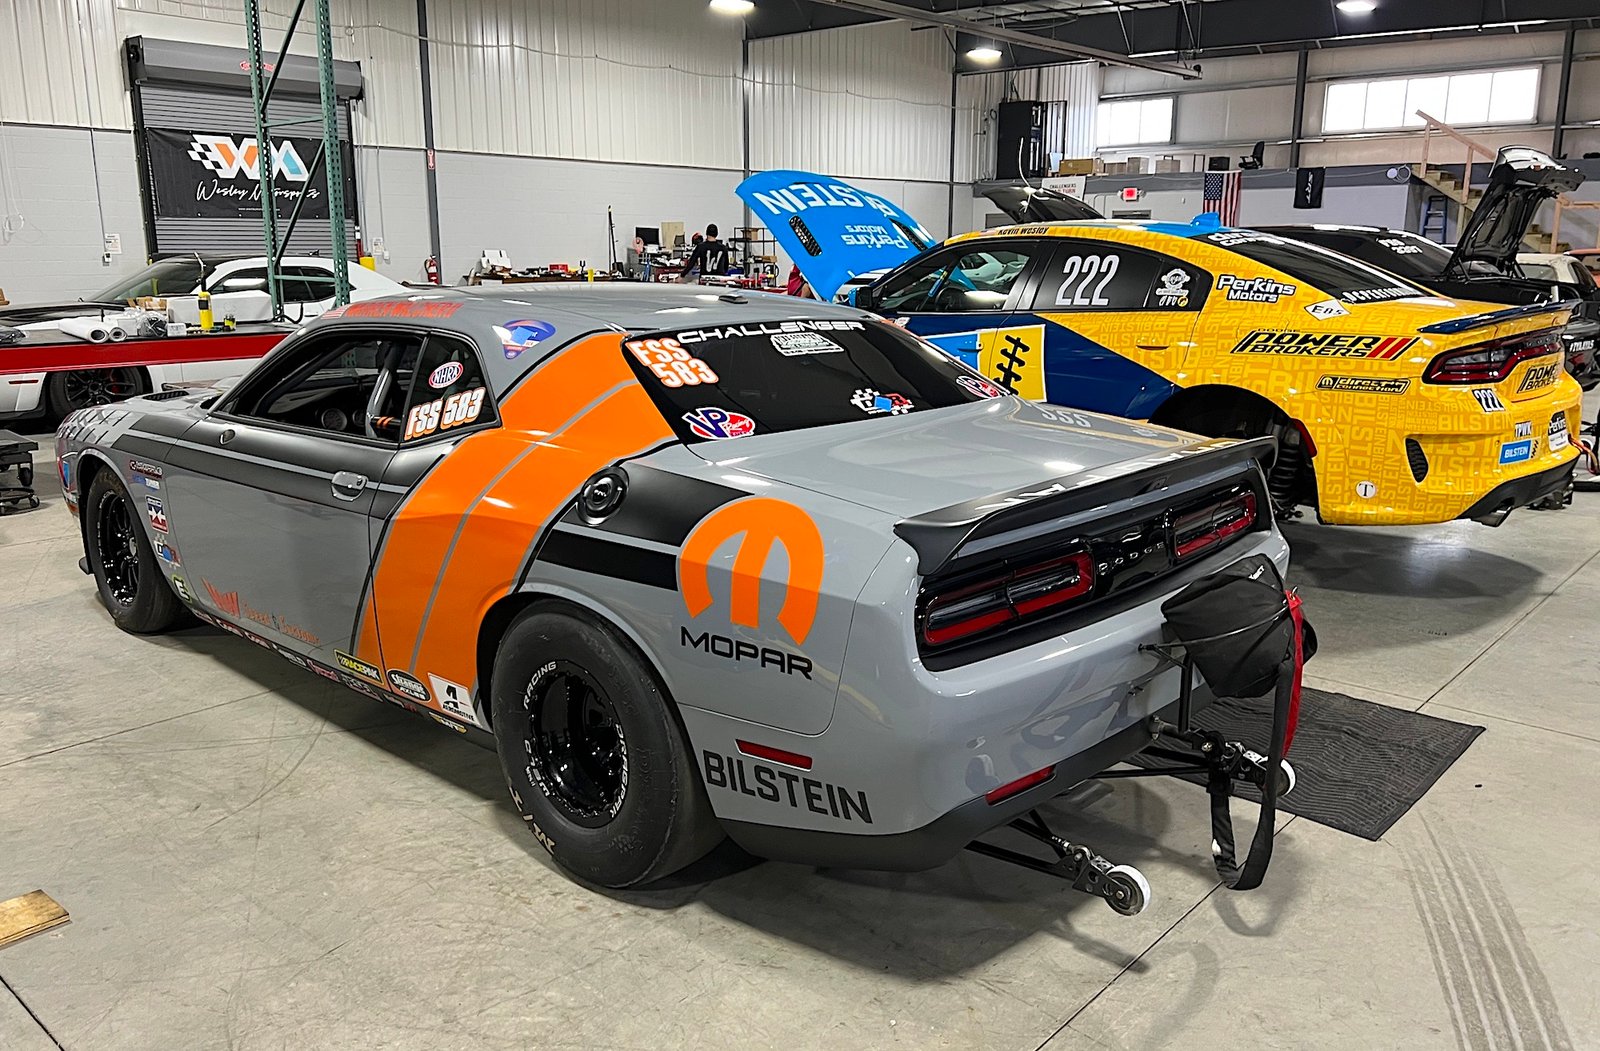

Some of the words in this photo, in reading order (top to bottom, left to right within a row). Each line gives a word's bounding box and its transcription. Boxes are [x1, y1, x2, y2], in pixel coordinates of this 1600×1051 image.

[196, 179, 248, 201] Wesley
[840, 234, 909, 249] Perkins
[841, 225, 888, 235] Motors
[706, 250, 723, 273] W
[1056, 255, 1120, 307] 222
[1218, 275, 1296, 295] Perkins
[1229, 288, 1279, 303] Motors
[677, 320, 866, 344] CHALLENGER
[1241, 331, 1382, 349] POWER
[626, 338, 693, 366] FSS
[1249, 345, 1369, 358] BROKERS
[434, 365, 459, 384] NHRA
[650, 358, 719, 388] 583
[1475, 388, 1504, 412] 222
[404, 399, 444, 441] FSS
[440, 387, 487, 430] 583
[682, 407, 730, 439] VP
[1504, 446, 1529, 459] BILSTEIN
[681, 625, 813, 681] MOPAR
[523, 661, 558, 710] RACING
[702, 748, 874, 825] BILSTEIN
